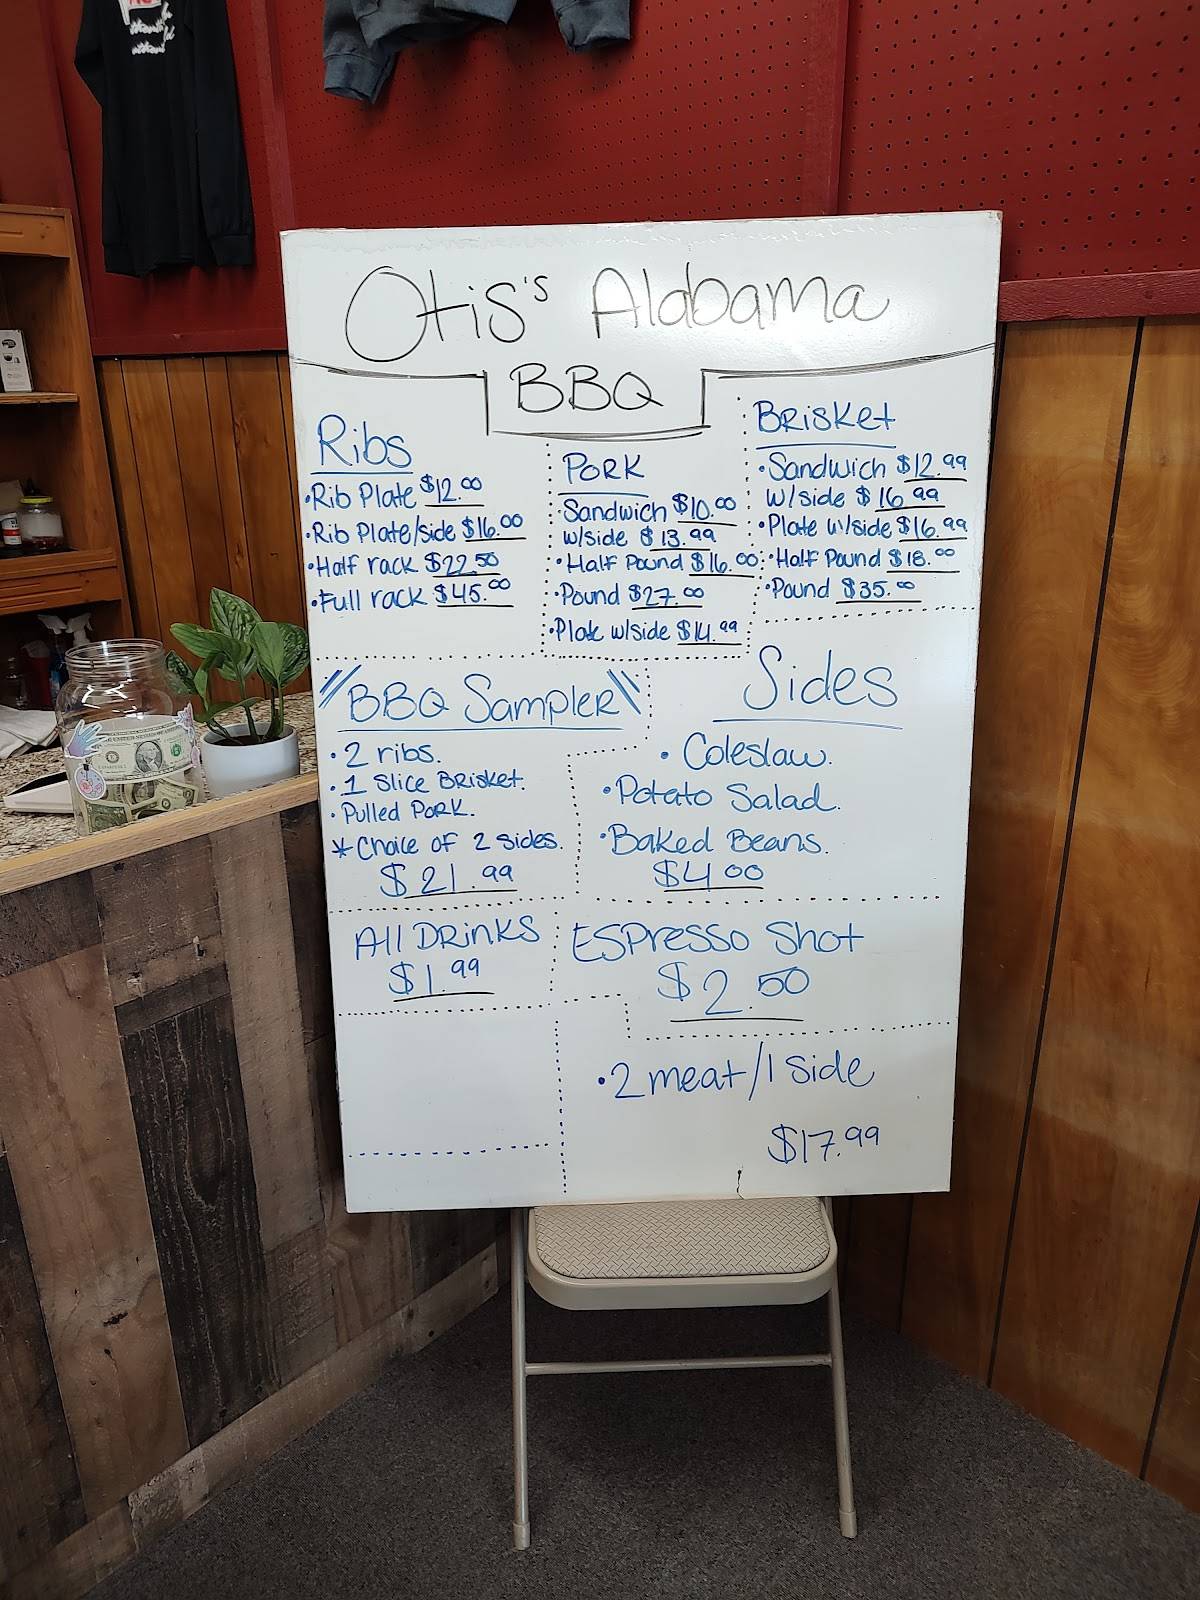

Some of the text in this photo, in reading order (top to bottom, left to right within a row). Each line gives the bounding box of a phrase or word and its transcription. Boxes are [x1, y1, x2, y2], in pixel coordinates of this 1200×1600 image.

[592, 262, 890, 339] Alabama
[510, 363, 663, 413] BBQ
[317, 415, 412, 468] Ribs
[769, 452, 967, 481] Sandwich $12.99
[310, 474, 482, 511] Rib Plate $12.00
[563, 492, 736, 522] Sandwich $10.00
[312, 513, 524, 546] Rib Plate/side $16.00
[563, 526, 628, 548] w/side
[768, 513, 818, 537] Plate
[896, 515, 967, 539] $16.99
[316, 555, 359, 577] Half
[367, 555, 419, 576] rack
[567, 553, 617, 573] Half
[626, 553, 683, 571] Pound
[776, 547, 818, 568] Half
[825, 548, 881, 568] Pound
[320, 578, 511, 612] Full rack $45.00
[559, 582, 704, 606] Pound $27.00
[771, 577, 915, 599] Pound $35.00
[611, 619, 671, 641] w/side
[743, 645, 898, 710] Sides
[348, 682, 450, 722] BBQ
[344, 742, 442, 768] 2 ribs.
[683, 732, 832, 770] Coleslaw.
[340, 775, 367, 796] 1
[616, 774, 841, 812] Potato Salad.
[341, 801, 400, 824] Pulled
[357, 834, 419, 860] Choice
[473, 832, 491, 850] 2
[727, 828, 829, 854] Beans.
[355, 925, 401, 960] All
[765, 921, 864, 955] Shot
[611, 1063, 645, 1098] 2
[768, 1124, 879, 1164] $17.99
